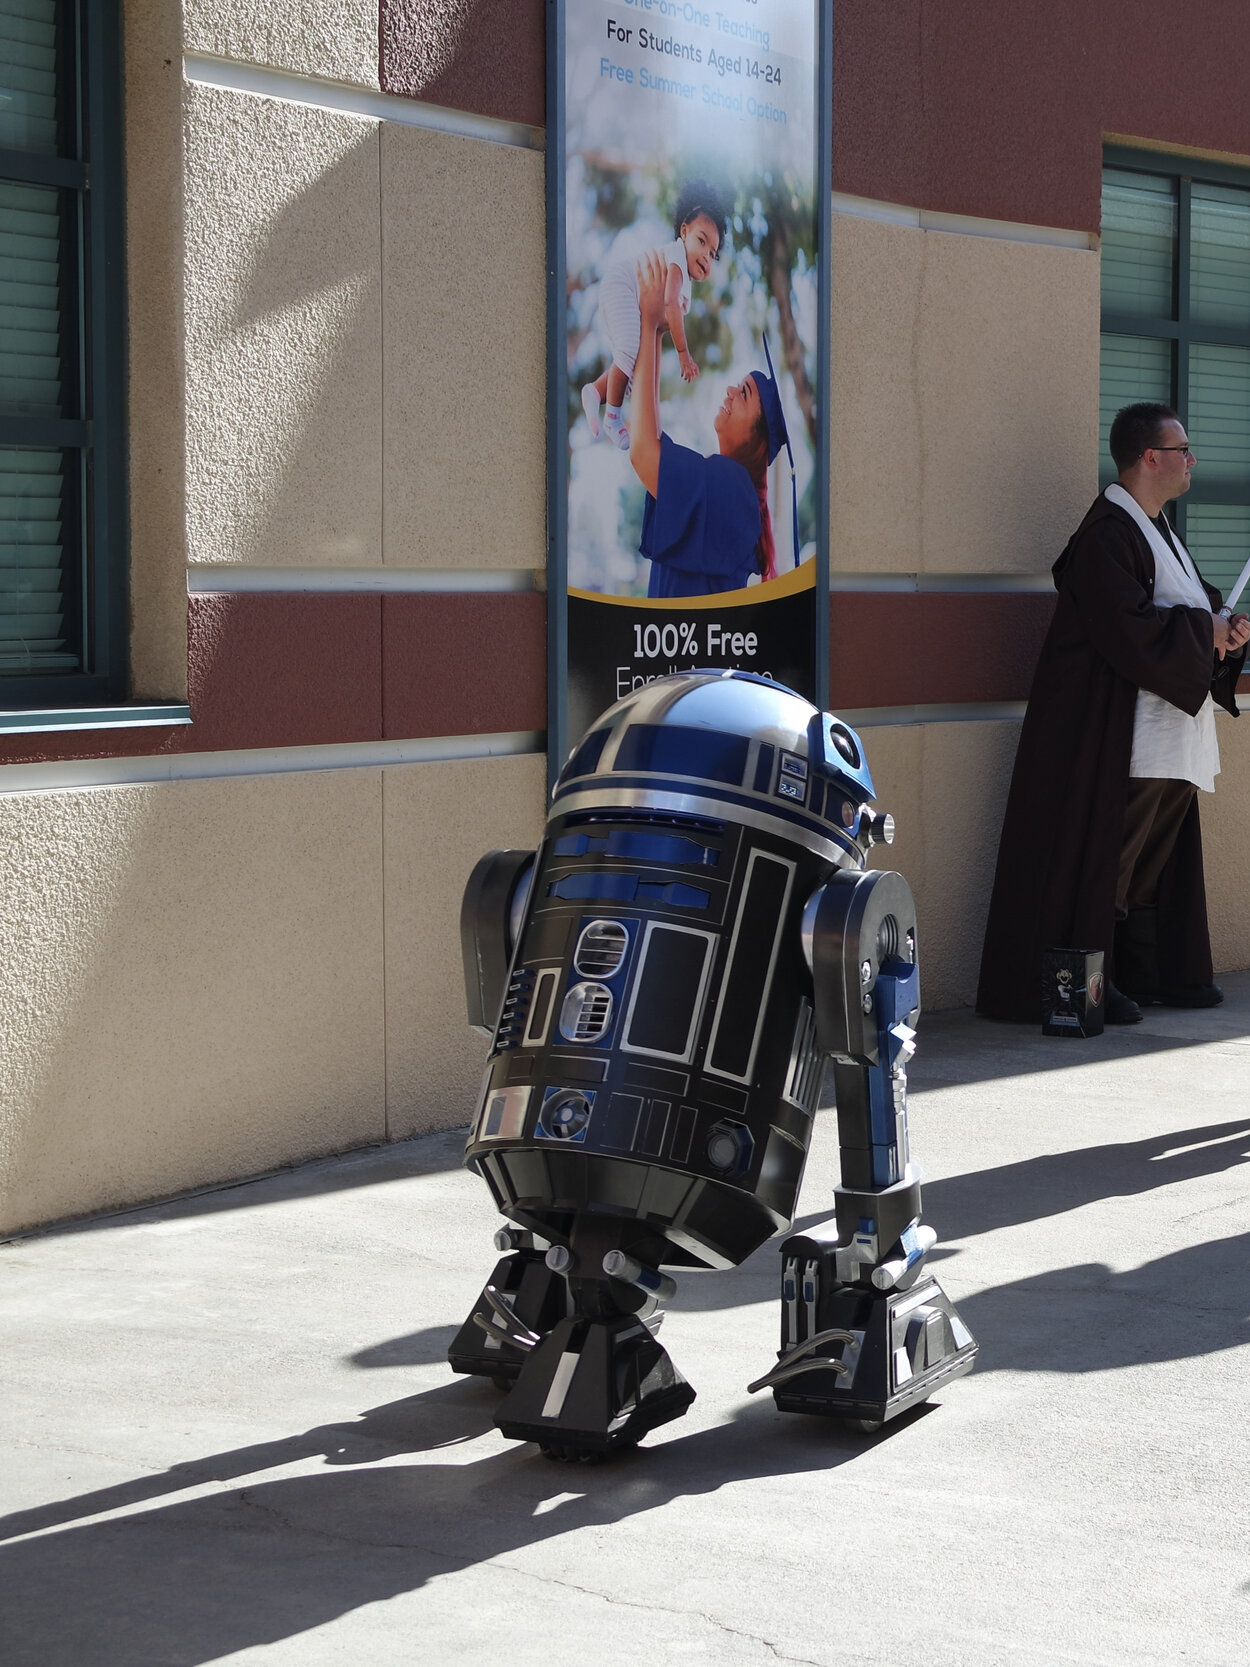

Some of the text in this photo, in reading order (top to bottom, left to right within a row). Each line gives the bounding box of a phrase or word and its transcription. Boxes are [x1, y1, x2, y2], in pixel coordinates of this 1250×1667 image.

[607, 19, 782, 86] For Students Aged 14-24
[623, 0, 770, 52] ne-on-One Teaching
[600, 58, 787, 124] Free Summer School Option
[633, 622, 758, 658] 100% Free
